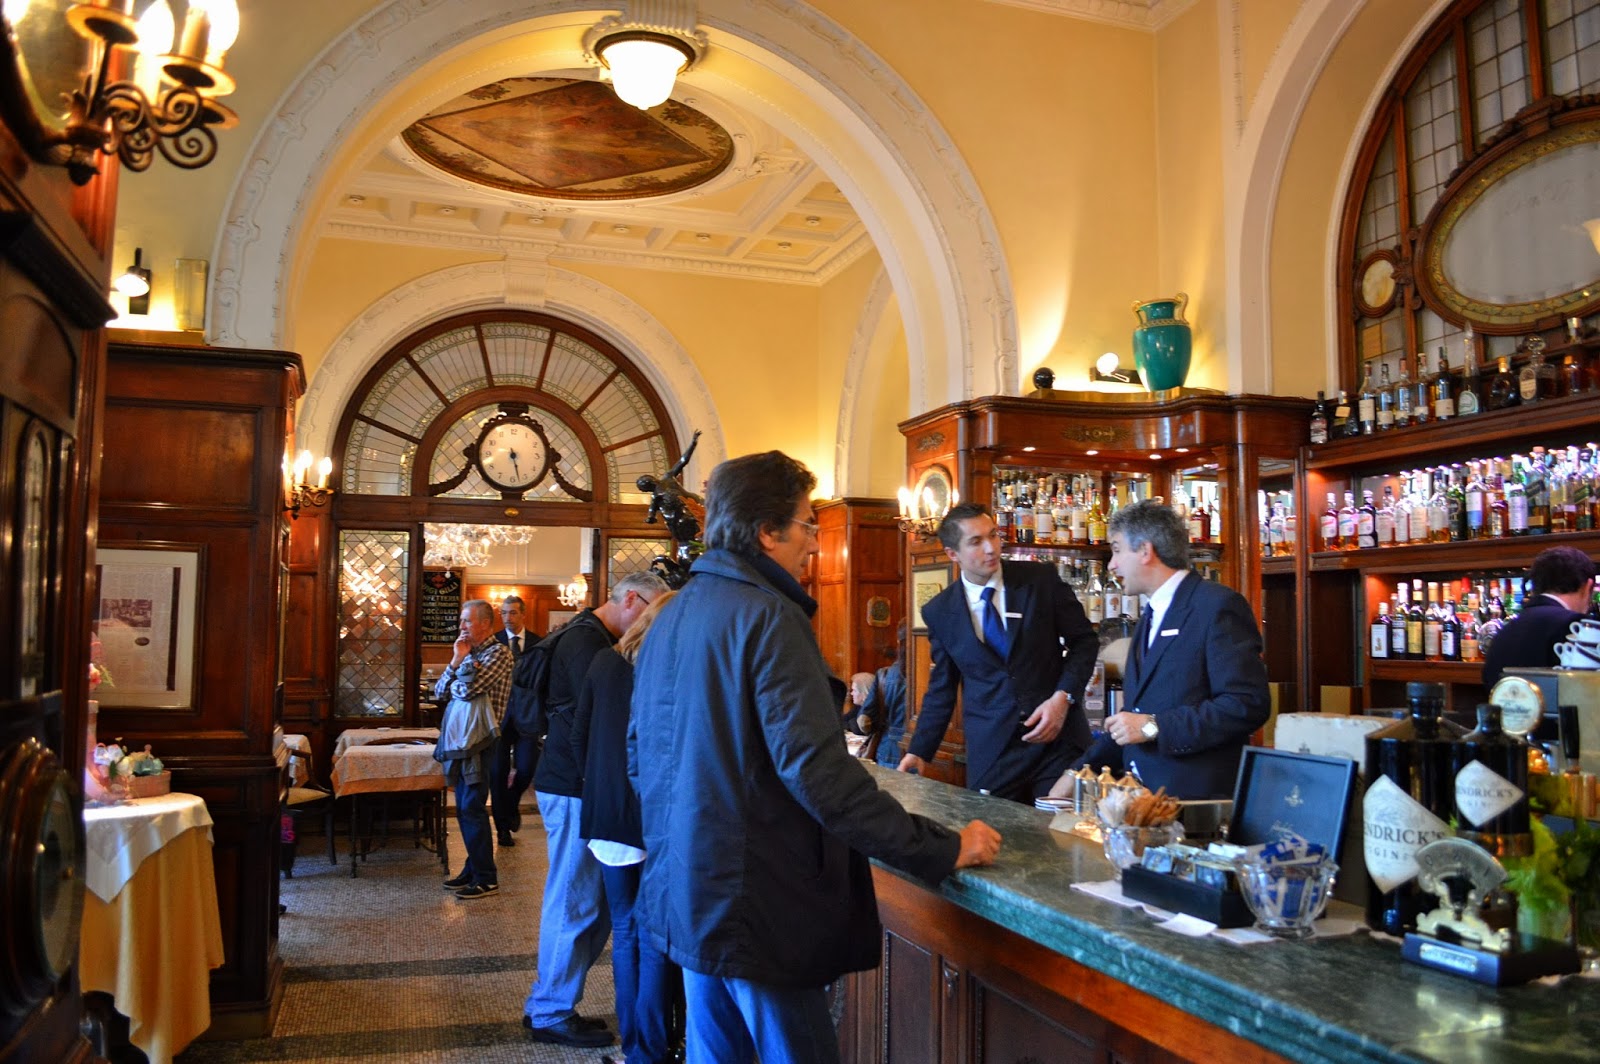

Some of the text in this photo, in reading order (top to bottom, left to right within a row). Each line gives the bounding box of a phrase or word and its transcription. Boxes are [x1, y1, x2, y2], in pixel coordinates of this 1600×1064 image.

[438, 581, 459, 595] GILLI
[1363, 822, 1446, 845] NDRICK'S
[1374, 847, 1399, 860] GIN
